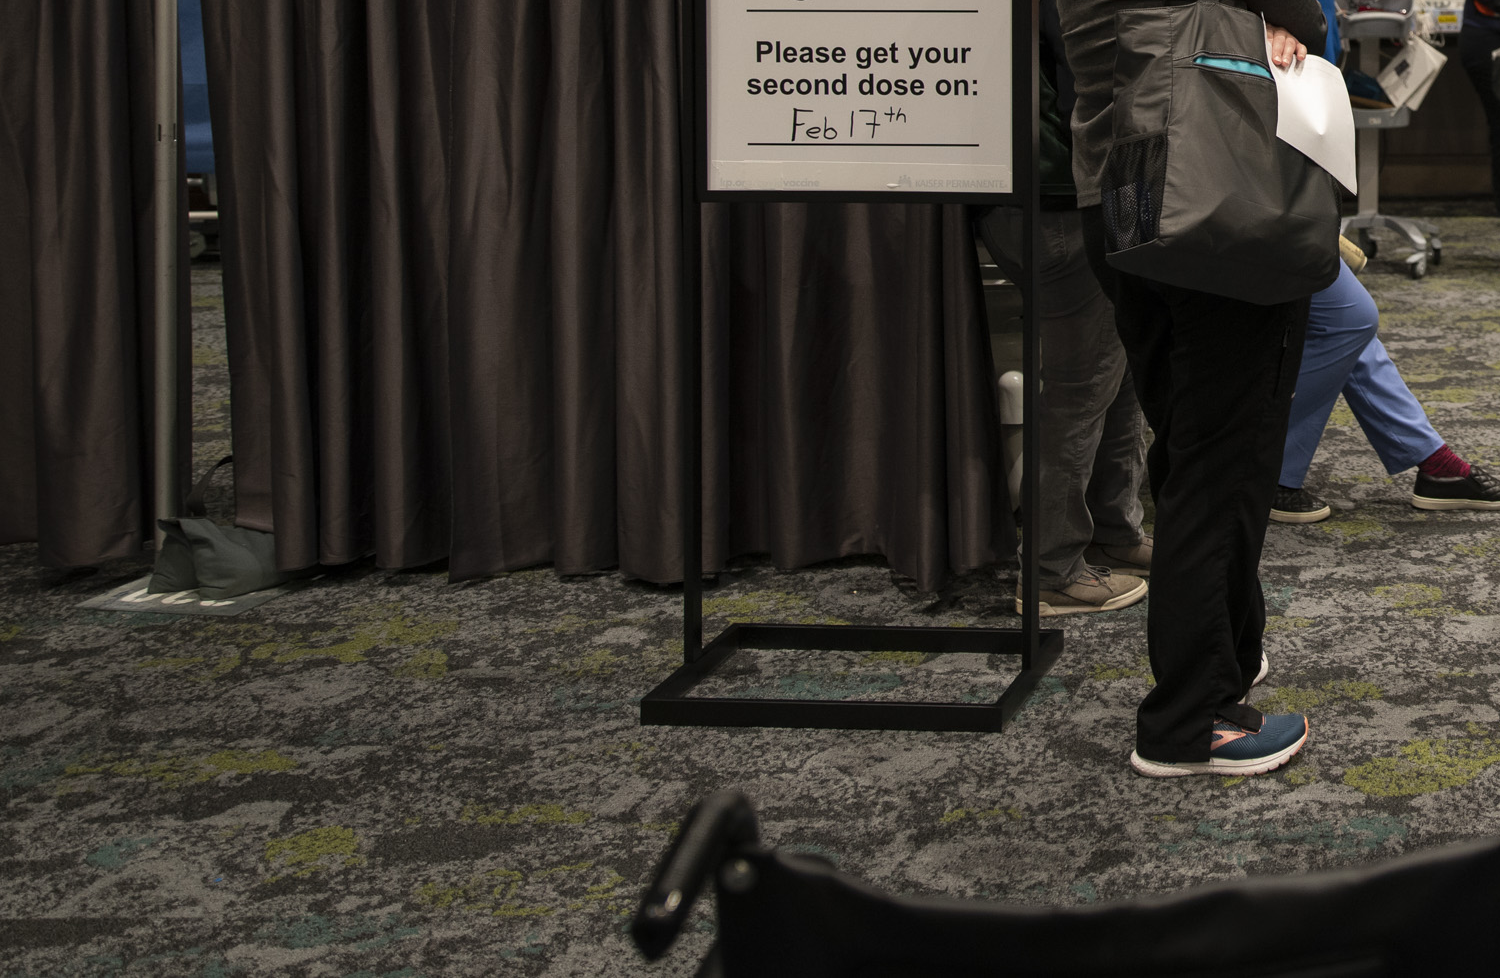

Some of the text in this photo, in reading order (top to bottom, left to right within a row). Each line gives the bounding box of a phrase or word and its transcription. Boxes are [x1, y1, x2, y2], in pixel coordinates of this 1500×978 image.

[756, 41, 971, 69] Please get your
[746, 73, 978, 96] second dose on:
[791, 106, 907, 142] Feb 17th
[915, 179, 943, 188] KAISER
